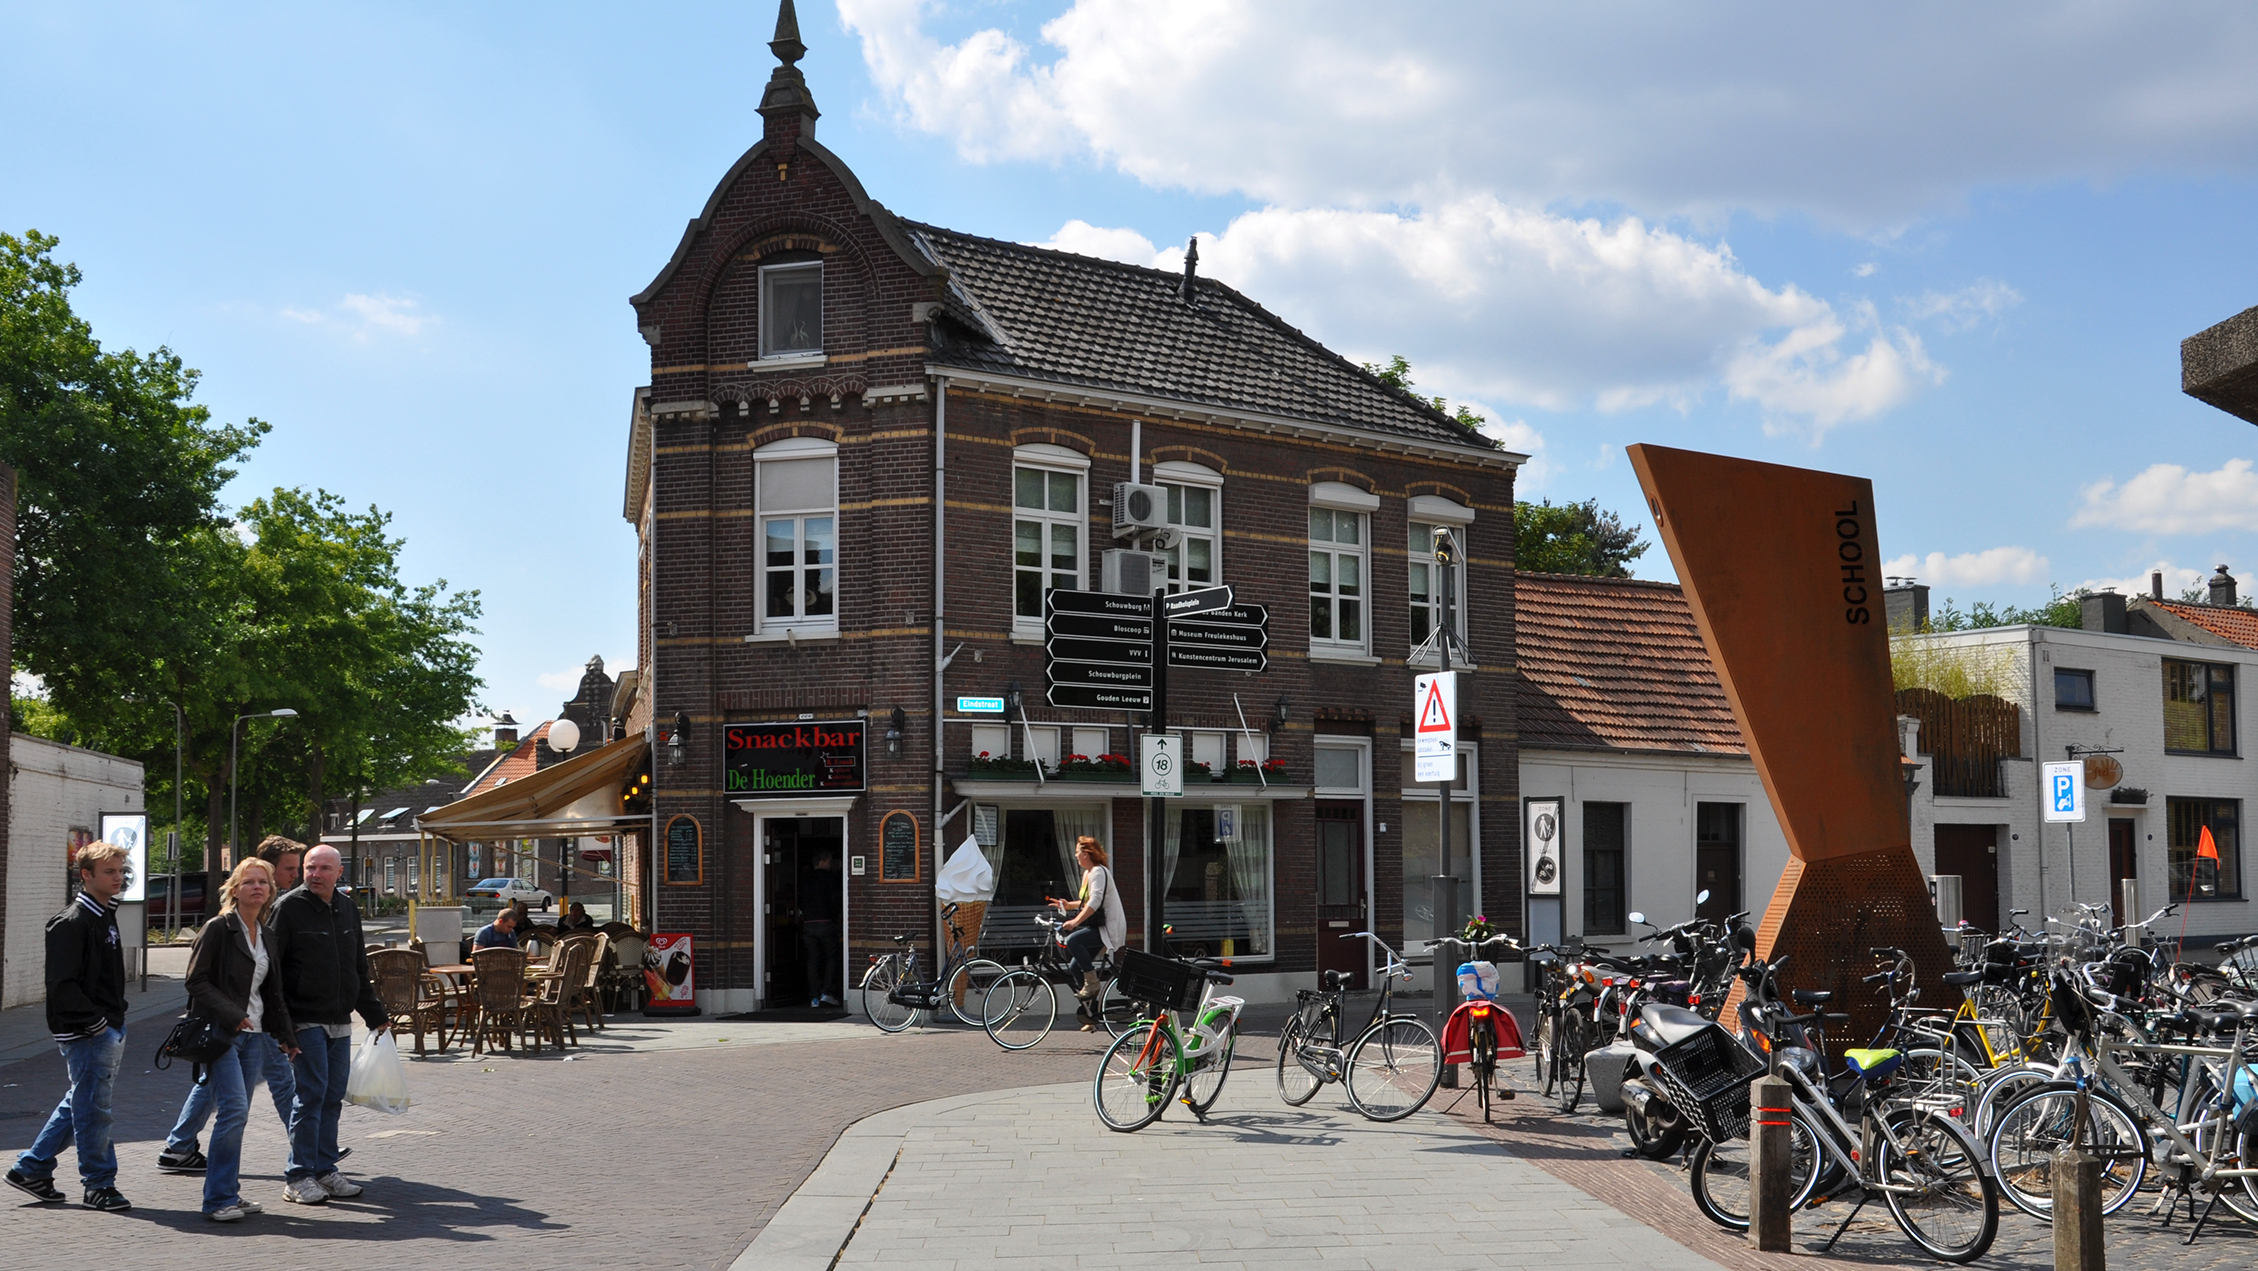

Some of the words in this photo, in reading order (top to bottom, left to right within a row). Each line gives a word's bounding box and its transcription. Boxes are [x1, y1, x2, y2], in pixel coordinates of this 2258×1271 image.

[1835, 500, 1870, 625] SCHOOL
[1105, 600, 1142, 612] Schouwburg
[1234, 610, 1248, 619] Kerk
[1113, 625, 1142, 634] Bioscoop
[1178, 630, 1203, 638] Museum
[1204, 631, 1247, 641] Freulekeshuus
[1128, 649, 1142, 657] VVV
[1178, 652, 1227, 662] Kunstencentrum
[1228, 655, 1258, 664] Jerusalem
[1088, 670, 1142, 680] Schouwburgplein
[962, 700, 999, 708] Eindstraat
[1096, 694, 1120, 702] Gouden
[1121, 695, 1141, 703] Leeuw
[727, 726, 861, 750] Snackbar
[1156, 759, 1168, 770] 18
[728, 769, 748, 790] De
[752, 767, 816, 790] Hoender
[2056, 777, 2071, 797] P
